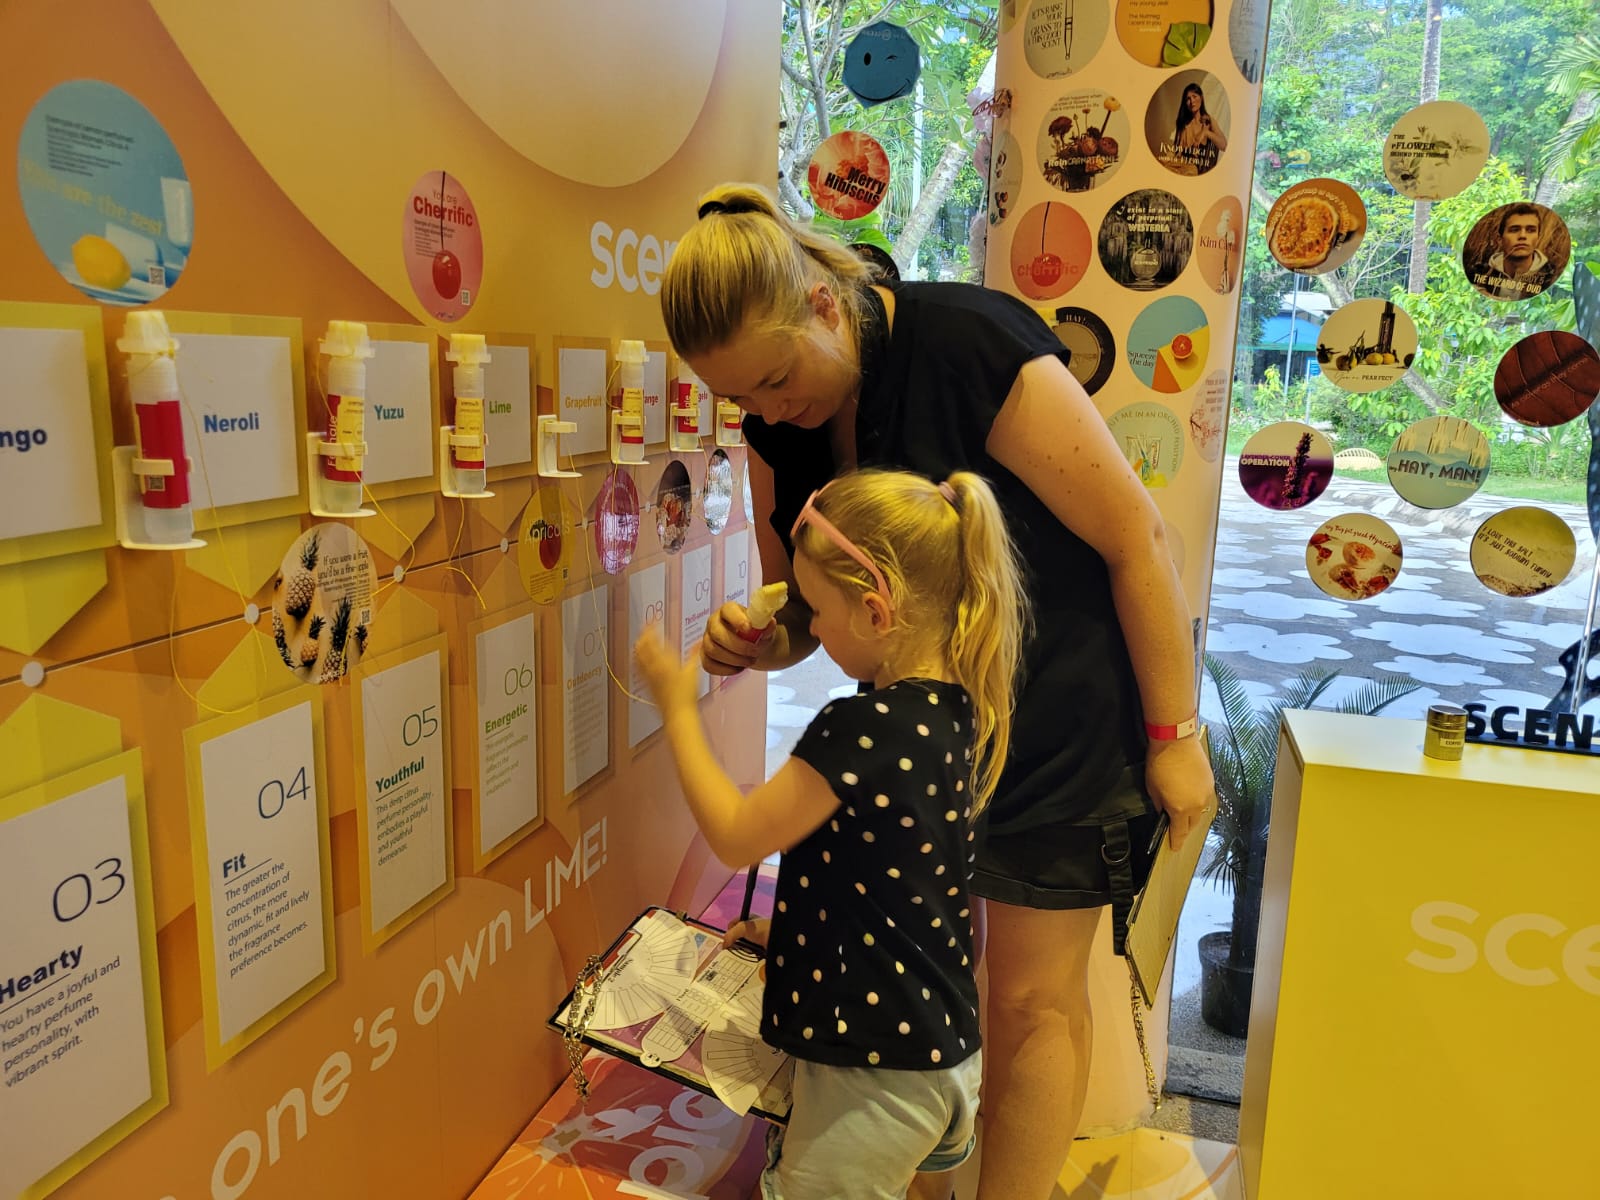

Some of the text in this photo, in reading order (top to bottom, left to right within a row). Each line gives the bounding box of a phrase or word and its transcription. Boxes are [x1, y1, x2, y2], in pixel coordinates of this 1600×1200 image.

[824, 172, 881, 207] Hibiscus
[847, 166, 886, 195] Merry
[413, 196, 473, 226] Cherrific
[1128, 224, 1170, 232] WISTERIA
[1200, 235, 1217, 249] Kim
[590, 221, 677, 295] sce
[1473, 273, 1542, 294] THE WIZARD OF OUD
[374, 404, 404, 420] Yuzu
[489, 400, 512, 415] Lime
[565, 394, 602, 410] Grapefruit
[204, 412, 259, 433] Neroli
[1241, 458, 1290, 467] OPERATION
[1438, 464, 1483, 483] MAN!
[329, 557, 340, 566] you
[1489, 541, 1505, 552] JUST
[695, 578, 710, 602] 09
[645, 600, 664, 625] 08
[504, 663, 533, 696] 06
[402, 705, 438, 747] 05
[485, 703, 528, 734] Energetic
[375, 756, 424, 793] Youthful
[258, 766, 311, 820] 04
[376, 785, 420, 816] This deep citrus
[376, 809, 402, 831] perfume
[377, 819, 405, 841] embodies
[410, 803, 428, 824] playful
[377, 825, 413, 855] and youthful
[222, 852, 247, 878] Fit
[524, 816, 608, 934] LIME!
[53, 857, 125, 922] 03
[226, 862, 285, 902] The greater the
[226, 871, 290, 916] concentration of
[227, 890, 288, 932] citrus, the more
[265, 911, 274, 924] fit
[274, 902, 289, 917] and
[290, 890, 310, 908] lively
[229, 923, 281, 962] the fragrance
[0, 944, 83, 1002] Hearty
[230, 943, 272, 980] preference
[413, 909, 511, 1026] own
[1, 955, 121, 1033] You have a joyful and
[1, 992, 94, 1052] hearty perfume
[4, 1004, 100, 1074] personality, with
[5, 1034, 83, 1088] vibrant spirit.
[210, 1007, 398, 1200] one's
